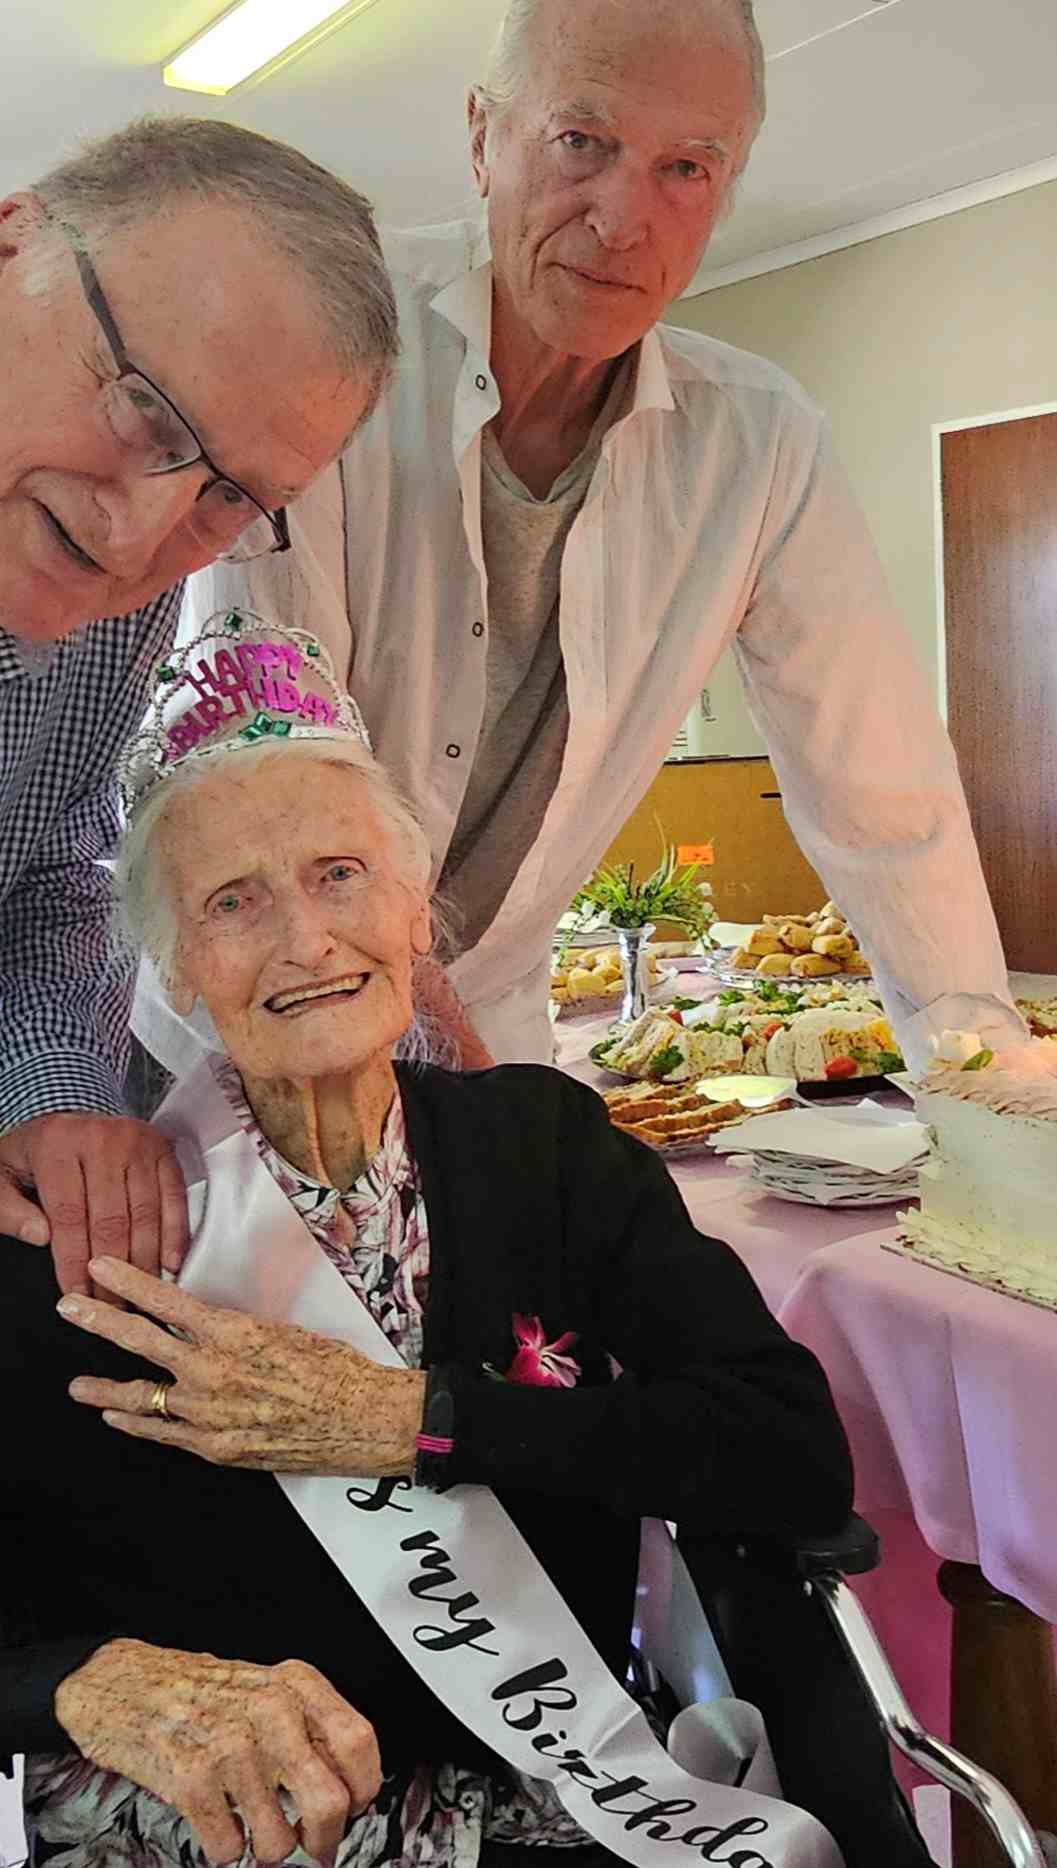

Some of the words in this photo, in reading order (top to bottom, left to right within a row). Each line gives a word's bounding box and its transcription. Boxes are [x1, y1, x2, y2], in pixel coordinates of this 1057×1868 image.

[183, 641, 303, 698] HAPPY
[166, 679, 337, 757] BIRTHDAY
[400, 1530, 500, 1656] my
